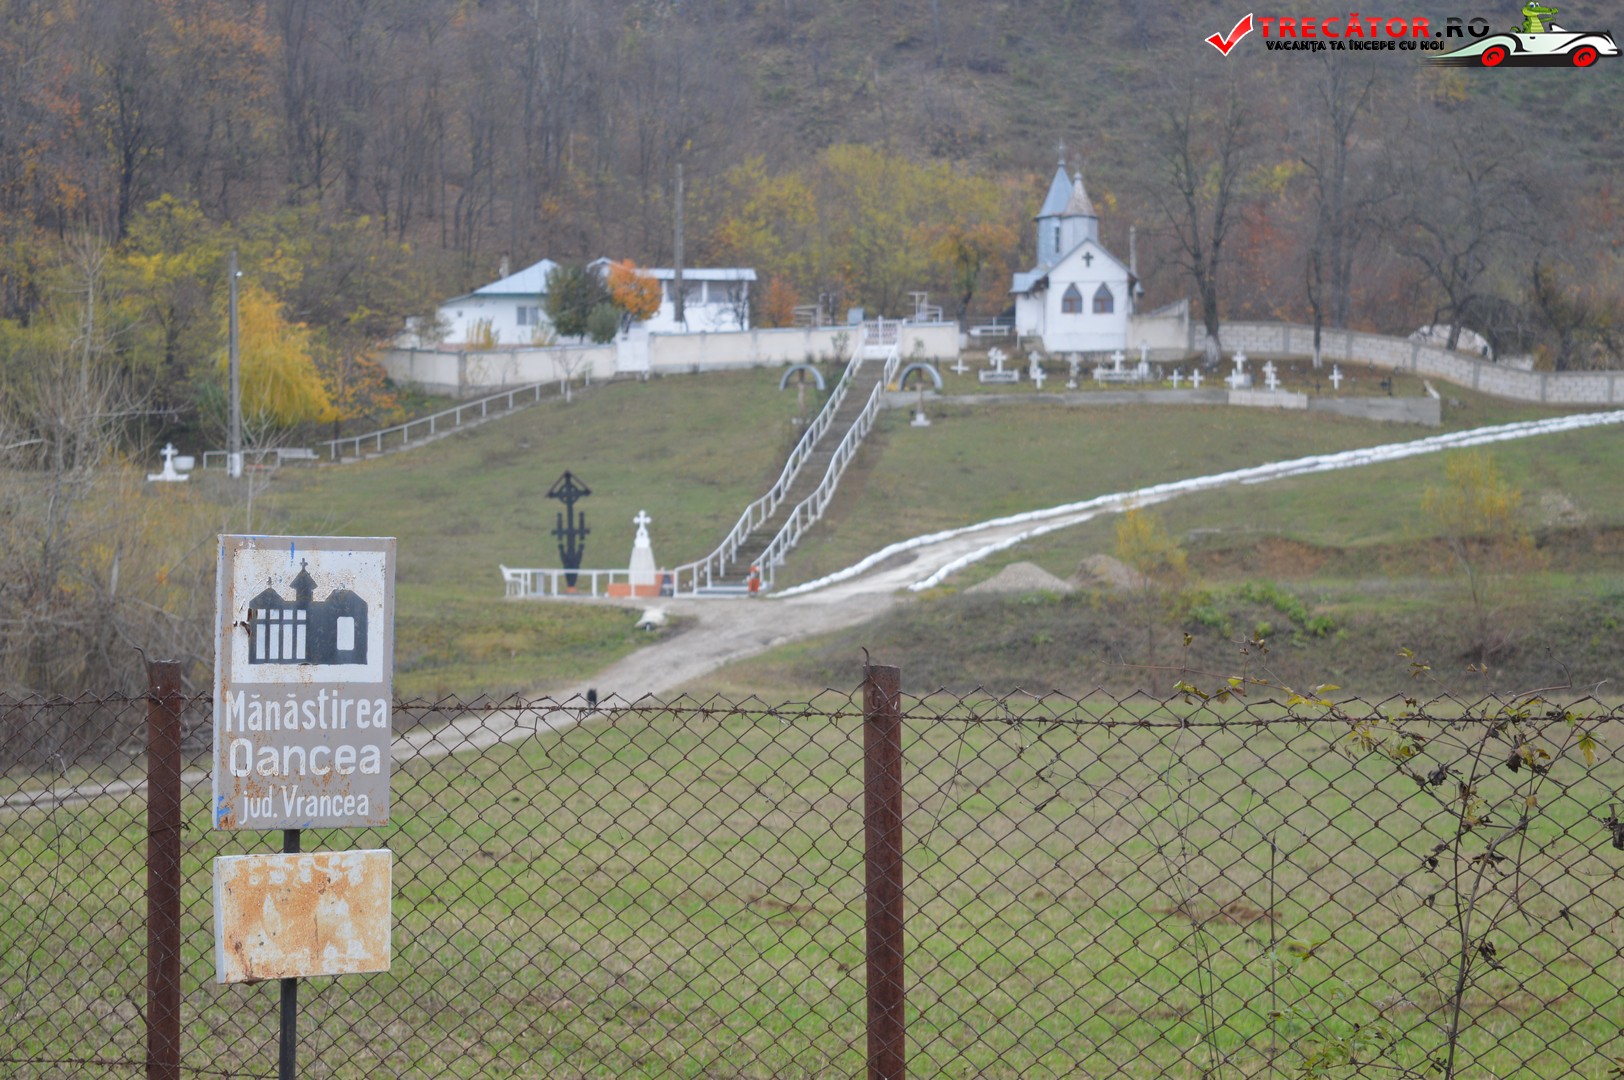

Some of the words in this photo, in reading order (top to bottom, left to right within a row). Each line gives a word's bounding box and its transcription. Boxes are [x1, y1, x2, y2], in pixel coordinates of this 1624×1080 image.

[225, 688, 387, 732] Mănăstirea
[229, 738, 381, 777] Oancea
[239, 785, 278, 825] jud.
[281, 785, 369, 818] Vrancea
